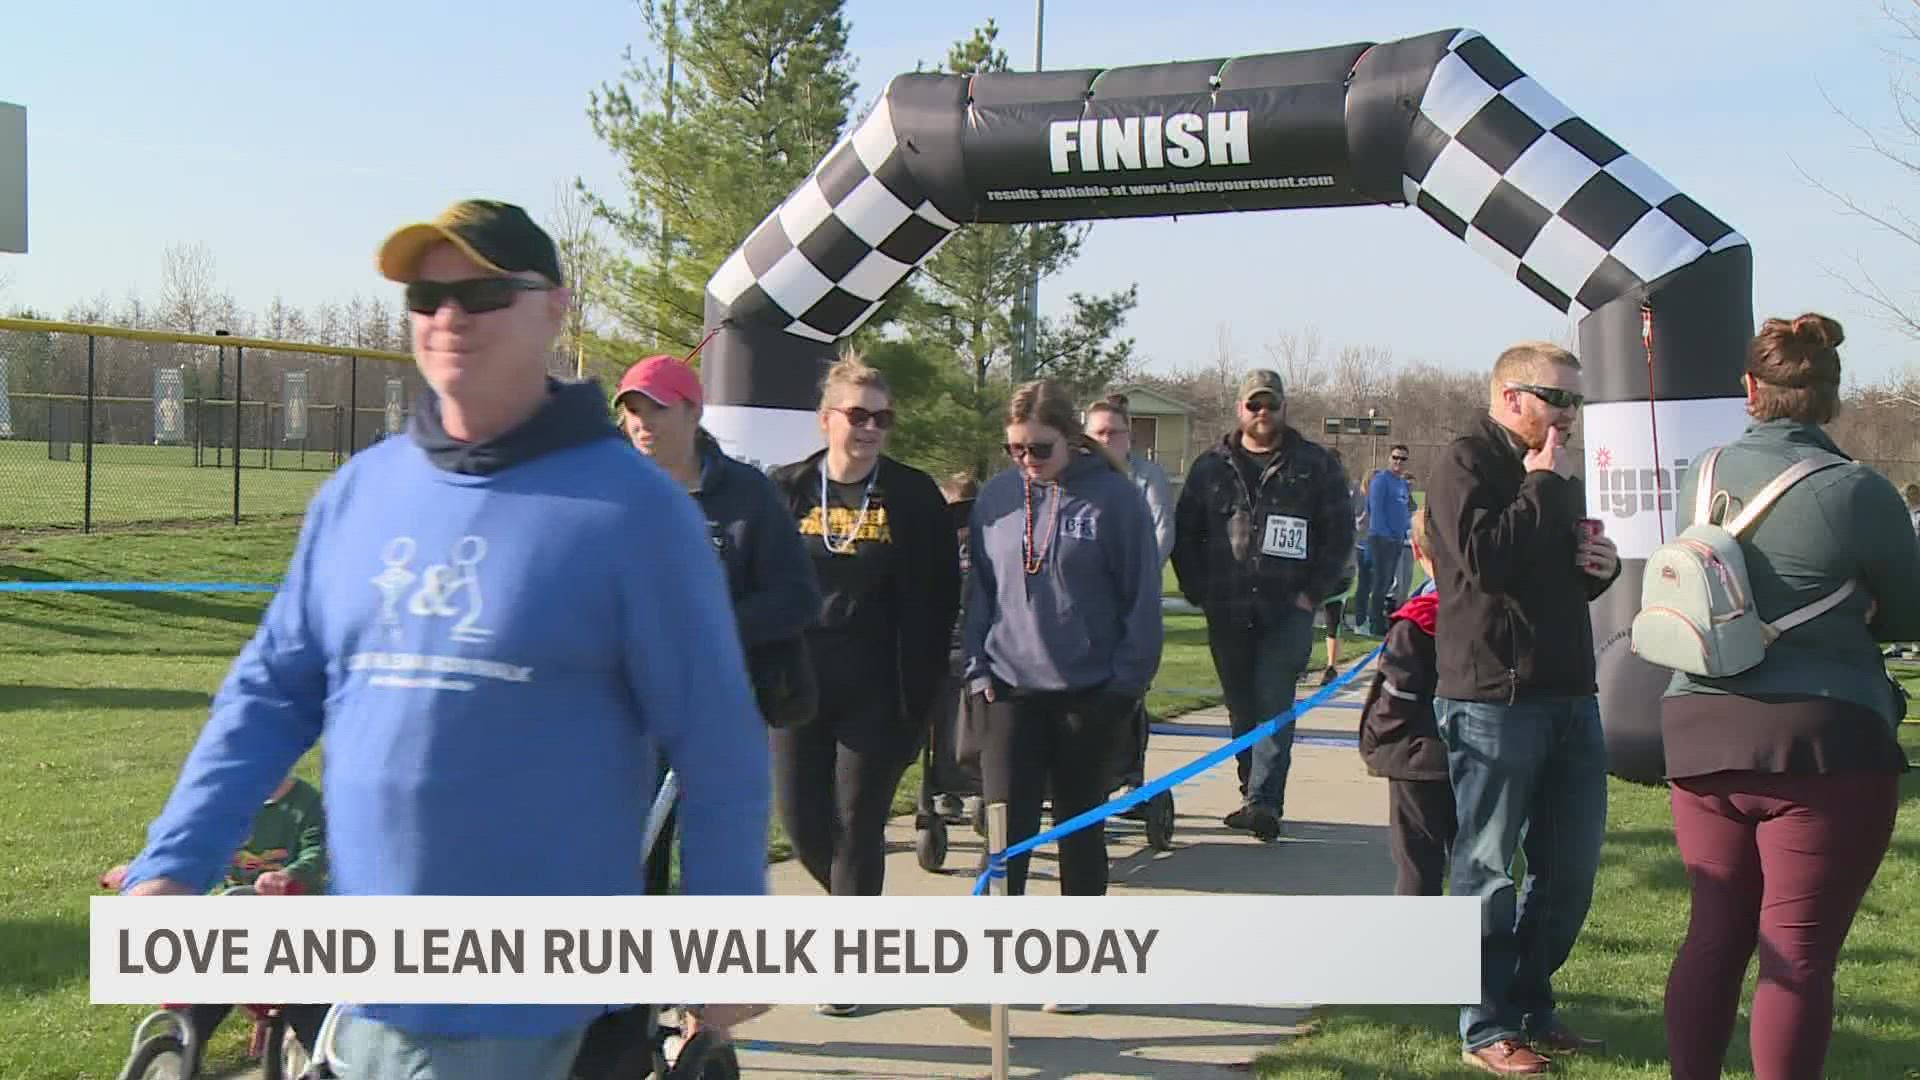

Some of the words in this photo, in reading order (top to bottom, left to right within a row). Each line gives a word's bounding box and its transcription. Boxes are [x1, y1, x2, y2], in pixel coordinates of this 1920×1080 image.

[1050, 110, 1250, 173] FINISH
[987, 188, 1039, 201] results
[1041, 184, 1109, 199] available
[1112, 185, 1129, 196] at
[1129, 174, 1335, 195] www.igniteyourevent.com
[1272, 527, 1304, 550] 1532
